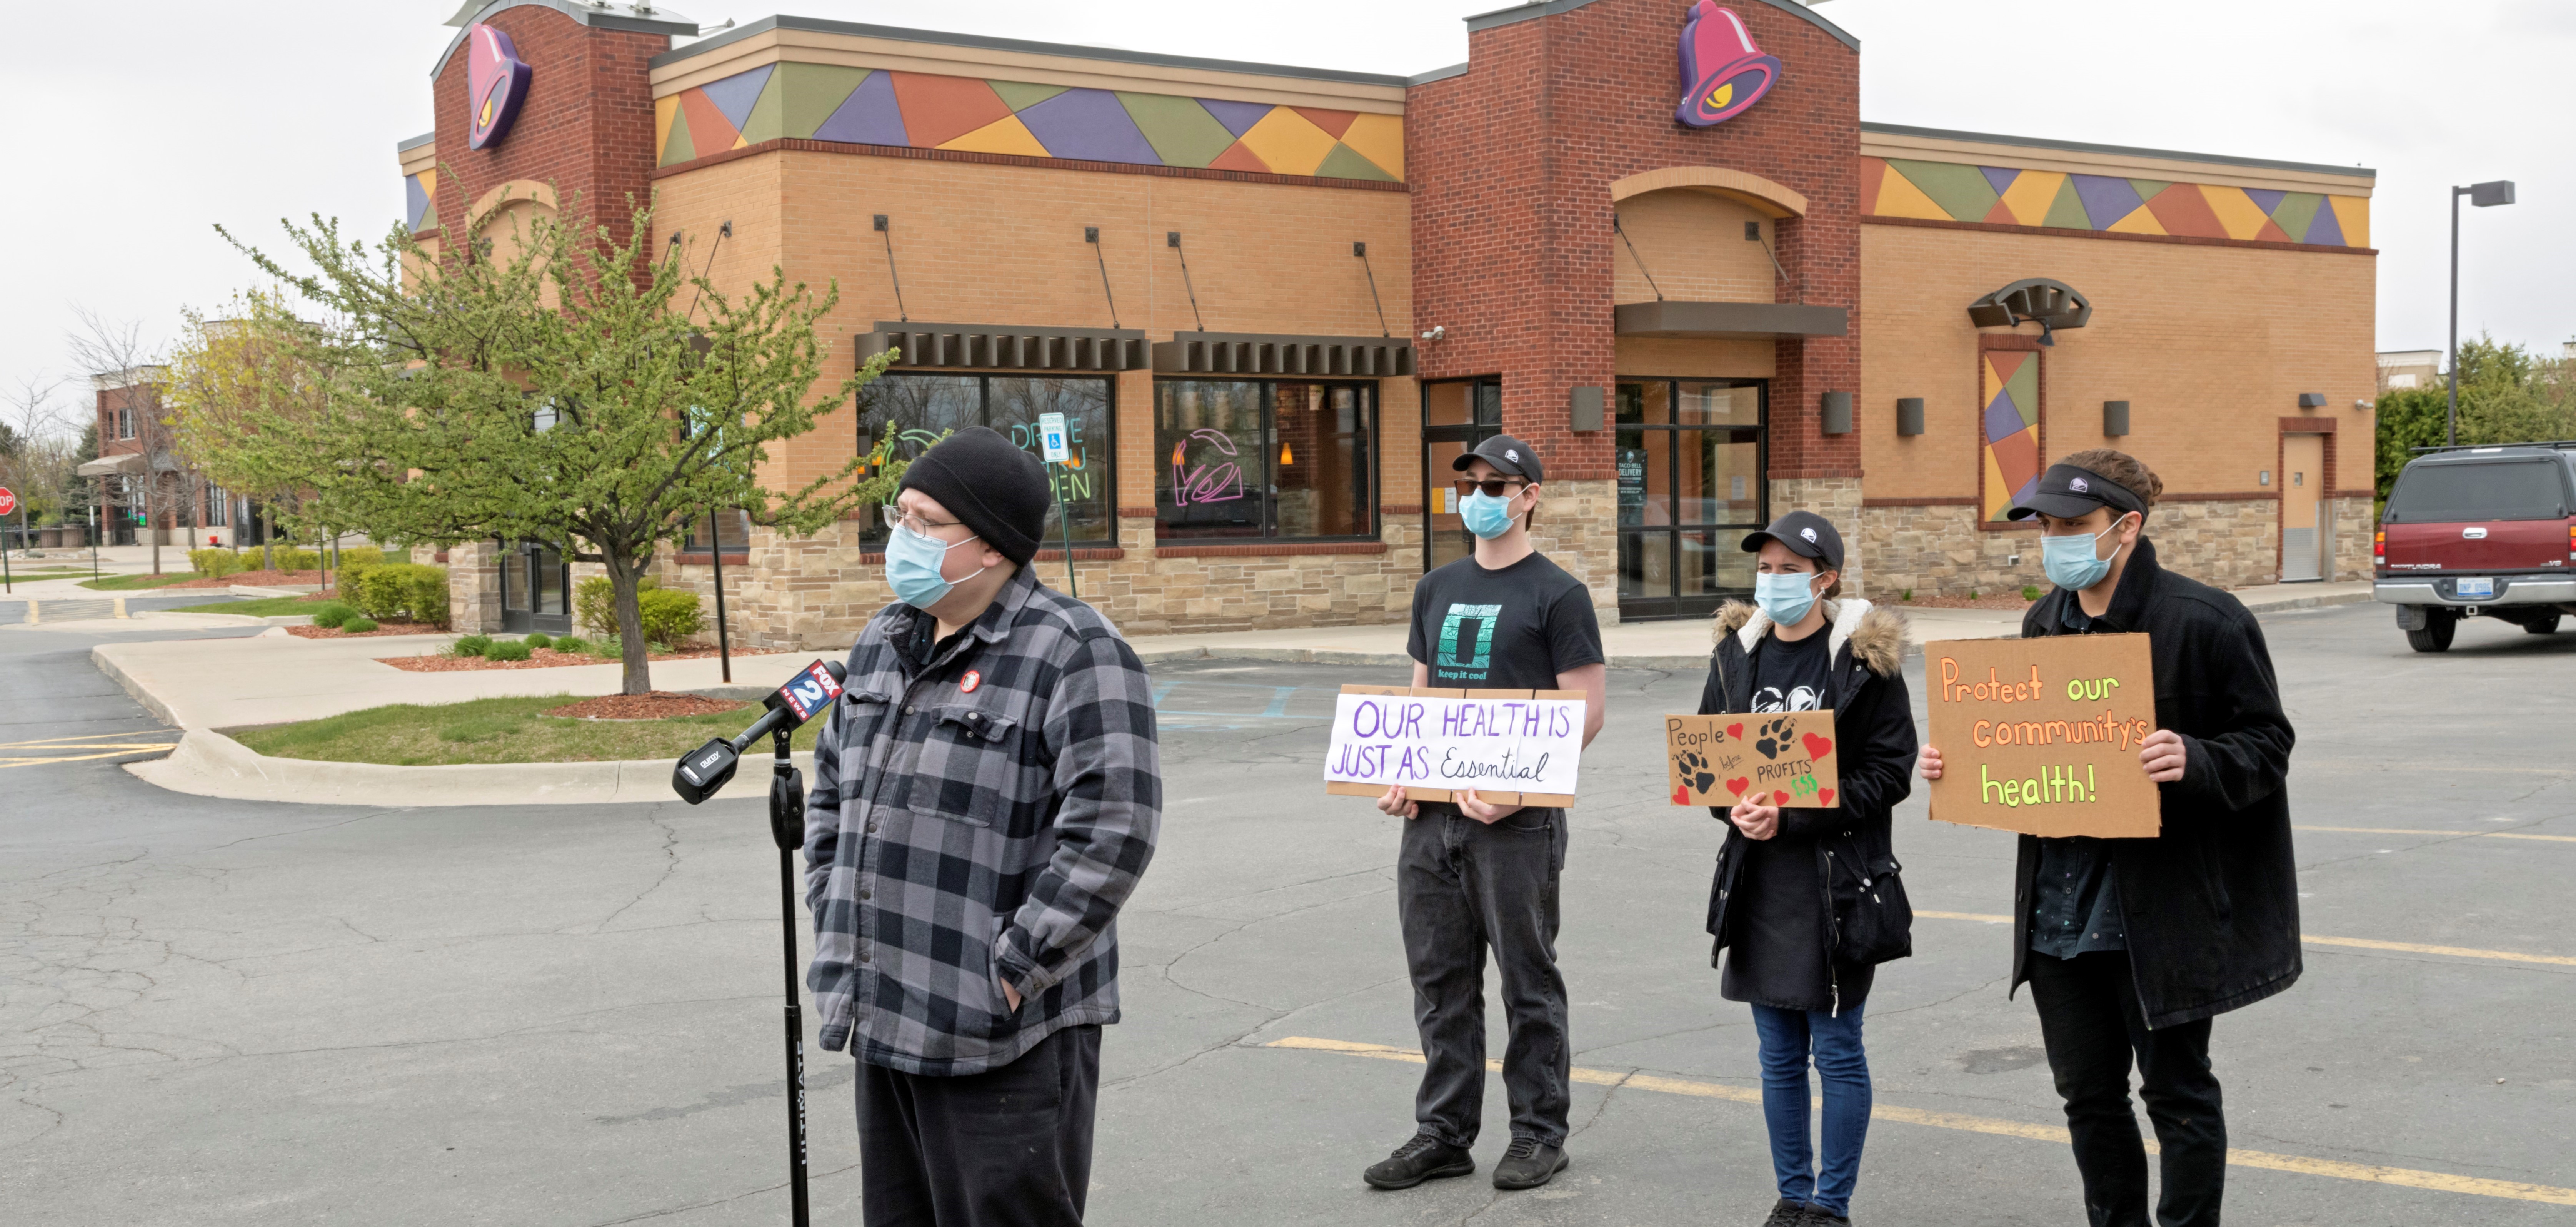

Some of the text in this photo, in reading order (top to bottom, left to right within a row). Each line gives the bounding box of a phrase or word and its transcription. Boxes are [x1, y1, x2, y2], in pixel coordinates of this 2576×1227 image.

[1012, 417, 1083, 450] DRE
[812, 665, 840, 696] FOX
[1438, 669, 1487, 680] keep it cool
[1940, 657, 2120, 703] Protect our
[782, 689, 807, 718] NEWS
[793, 680, 823, 709] 2
[1353, 700, 1570, 739] OUR HEALTH IS
[1668, 718, 1724, 754] People
[1972, 710, 2148, 751] community's
[700, 751, 719, 769] auray
[1332, 743, 1549, 782] JUST AS Essential
[1719, 754, 1742, 770] before
[1757, 759, 1812, 784] PROFITS
[1981, 763, 2096, 808] health!
[797, 1040, 807, 1164] ULTIMATE
